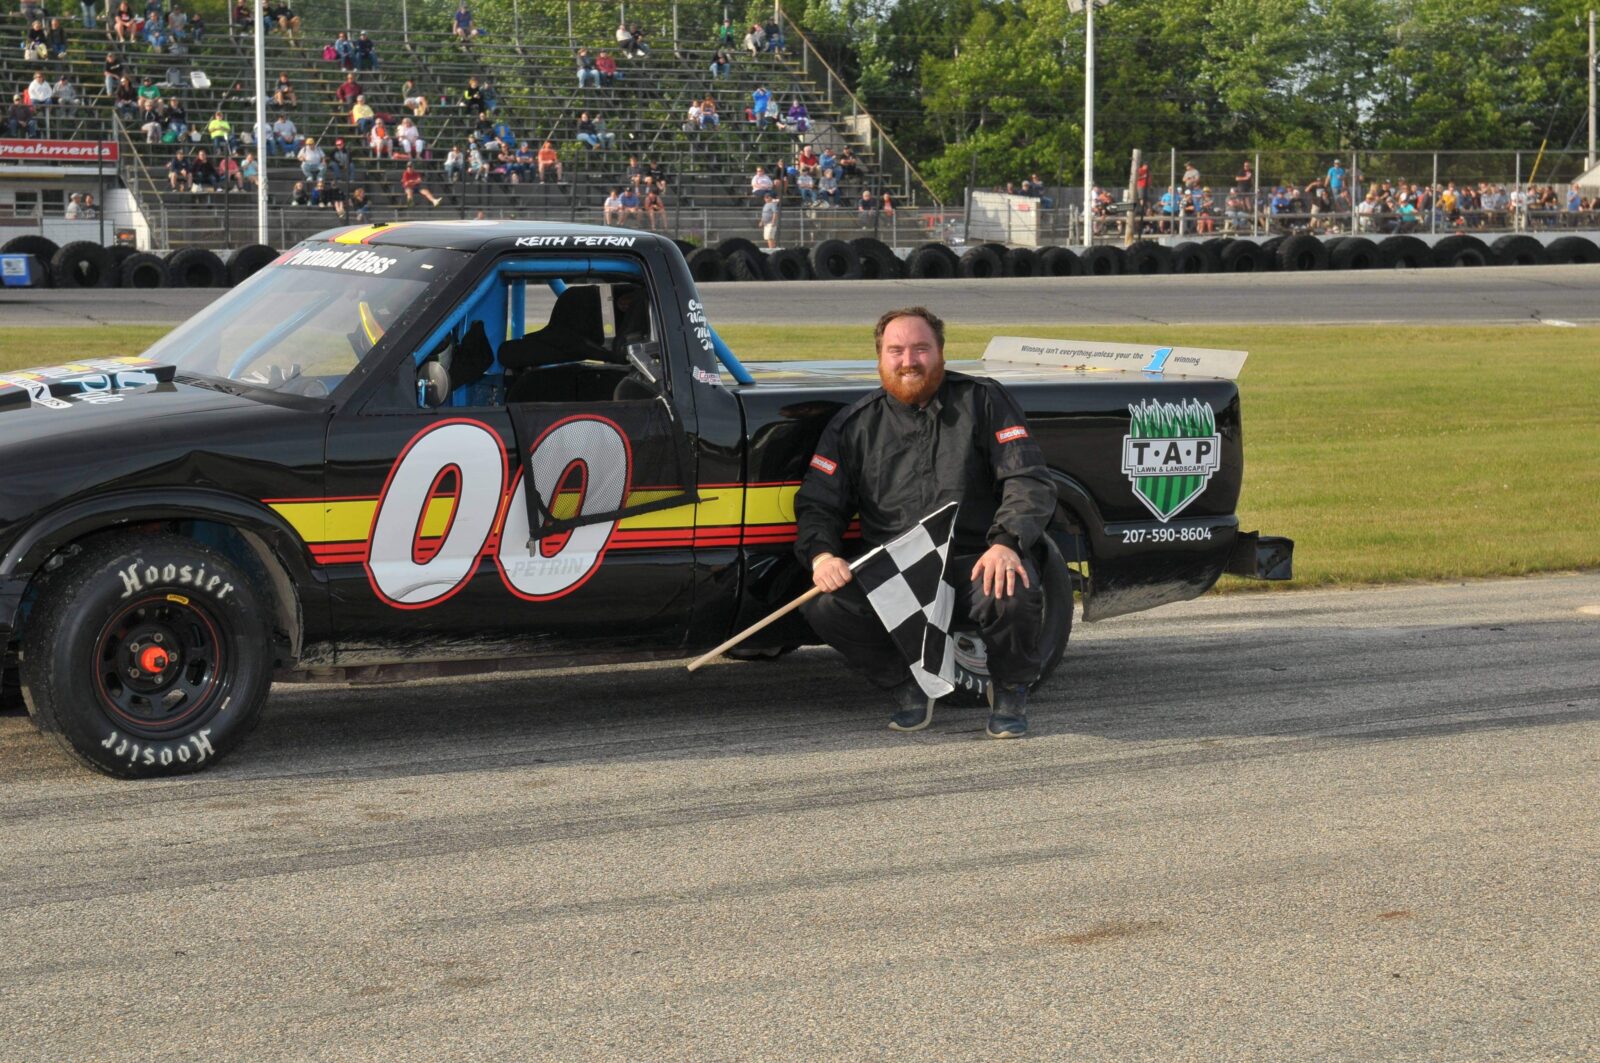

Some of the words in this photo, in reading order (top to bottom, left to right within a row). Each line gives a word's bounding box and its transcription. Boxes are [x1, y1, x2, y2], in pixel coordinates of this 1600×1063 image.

[515, 236, 568, 247] KEITH
[573, 236, 636, 247] PETRIN
[341, 250, 397, 275] Glass
[1021, 345, 1044, 354] Winning
[1115, 352, 1131, 360] your
[1141, 347, 1173, 373] 1
[1174, 356, 1201, 366] winning
[1165, 465, 1205, 473] LANDSCAPE
[363, 413, 633, 610] 00
[1122, 527, 1212, 543] 207-590-8604
[118, 559, 234, 599] Hoosier
[511, 557, 584, 579] PETRIN
[101, 728, 215, 768] Hoosier
